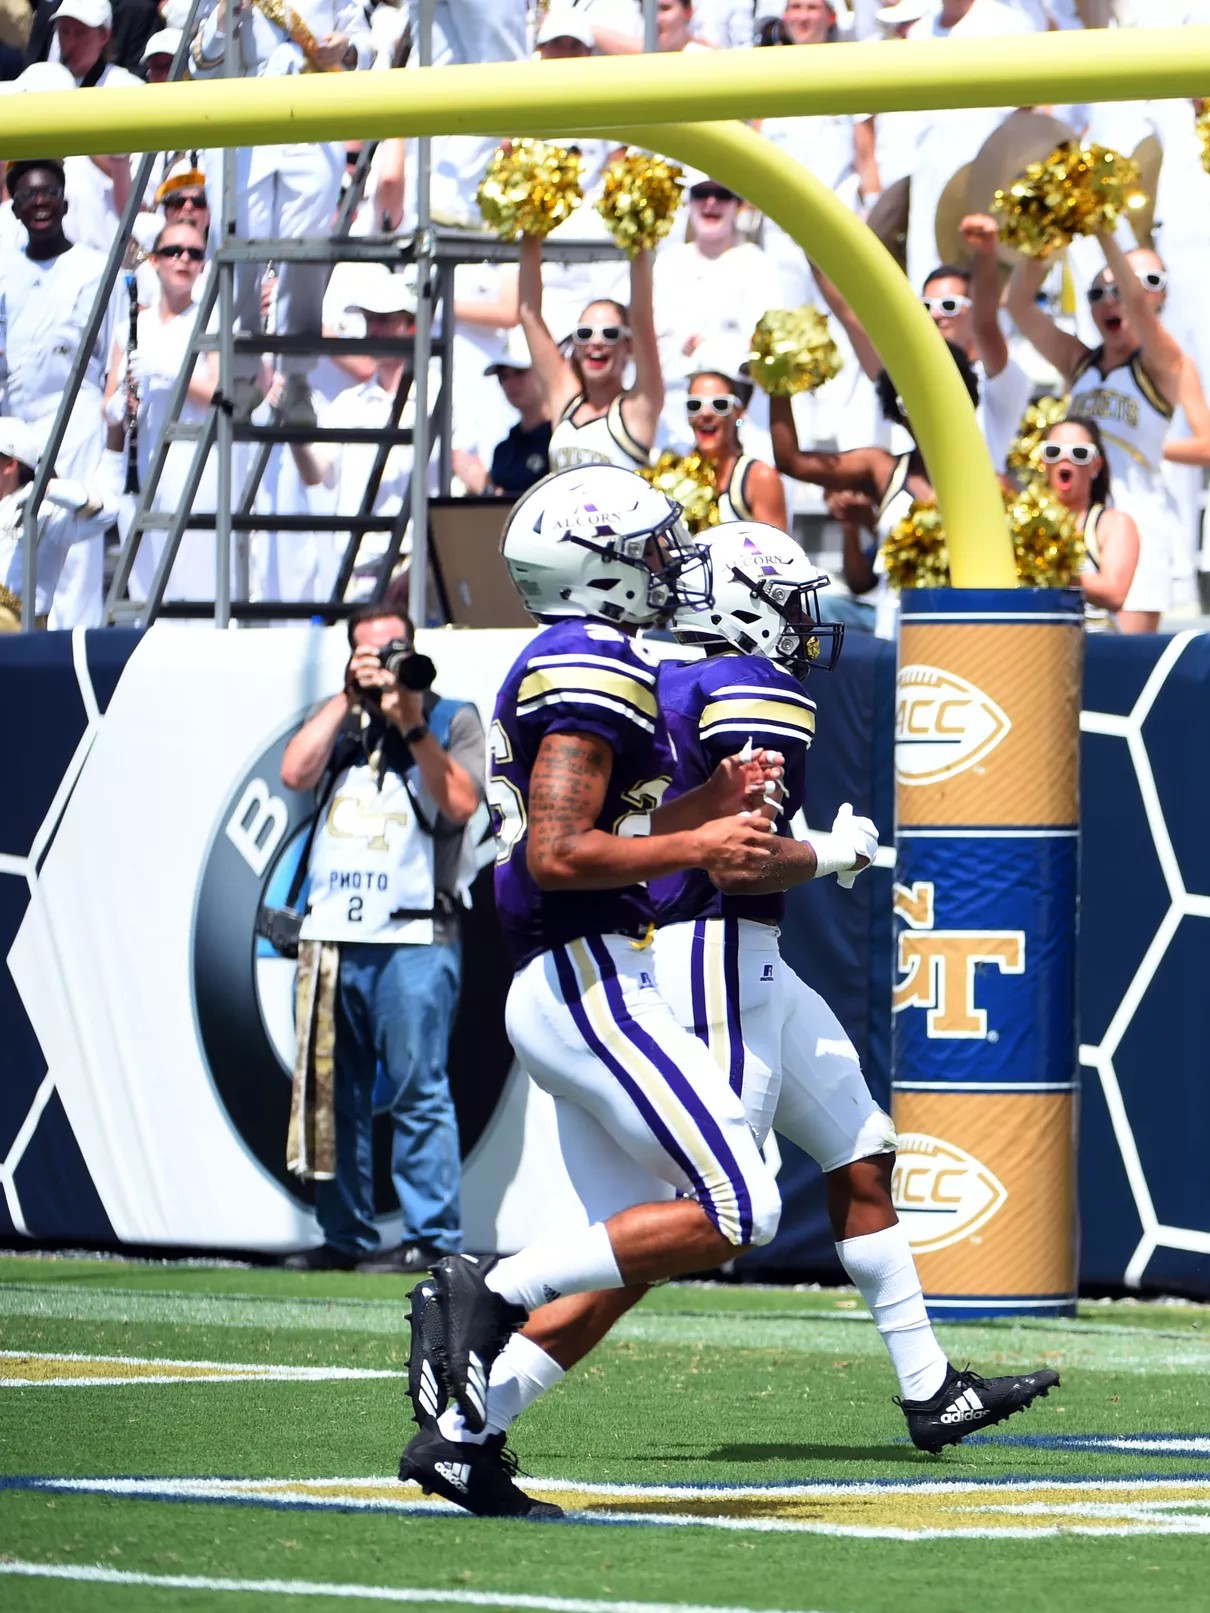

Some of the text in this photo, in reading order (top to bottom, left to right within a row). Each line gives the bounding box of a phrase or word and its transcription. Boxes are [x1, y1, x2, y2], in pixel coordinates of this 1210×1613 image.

[329, 871, 388, 891] PHOTO
[347, 896, 364, 922] 2
[940, 1408, 991, 1424] adidas
